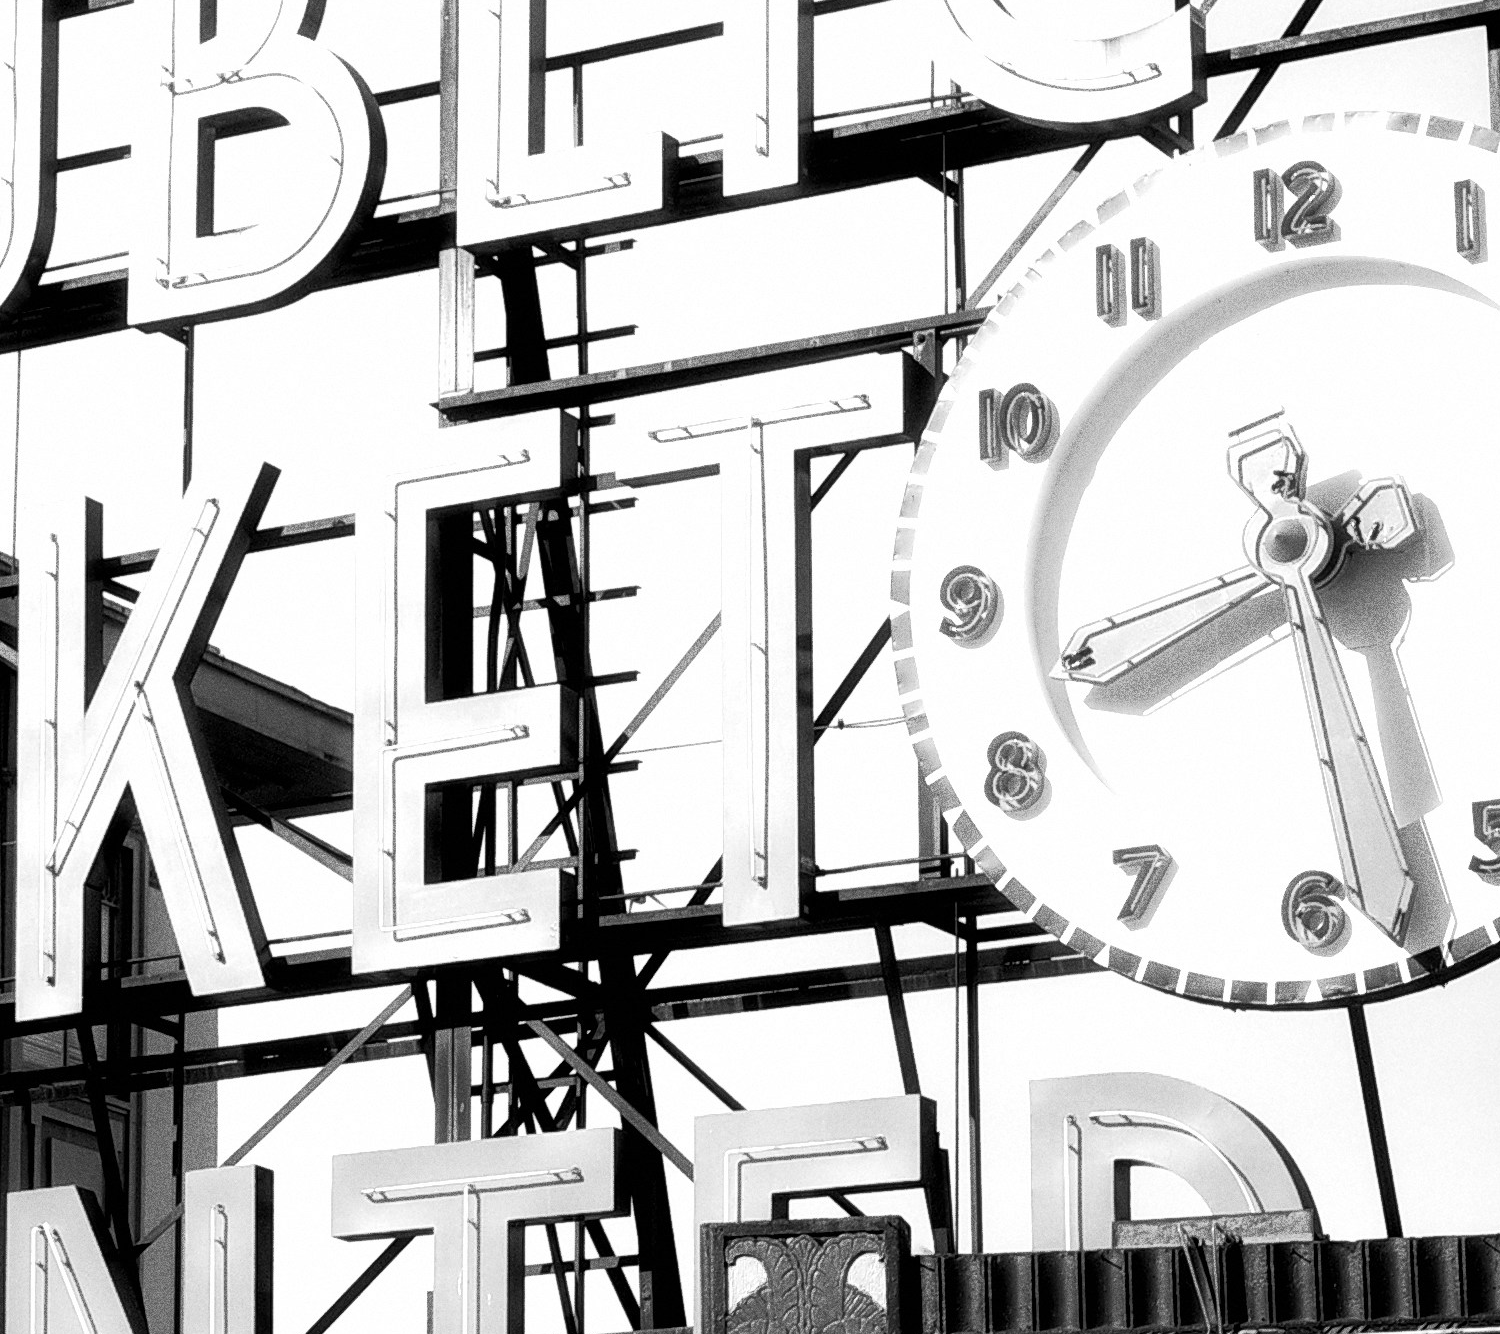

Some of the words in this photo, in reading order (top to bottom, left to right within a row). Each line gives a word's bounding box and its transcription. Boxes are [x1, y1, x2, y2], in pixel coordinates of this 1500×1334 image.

[1254, 161, 1342, 253] 12
[1454, 179, 1488, 264] 1
[1096, 236, 1162, 328] 11
[978, 382, 1061, 471] 10
[939, 565, 1004, 648] 9
[984, 731, 1052, 821] 8
[1113, 844, 1178, 930] 7
[1281, 869, 1353, 958] 6
